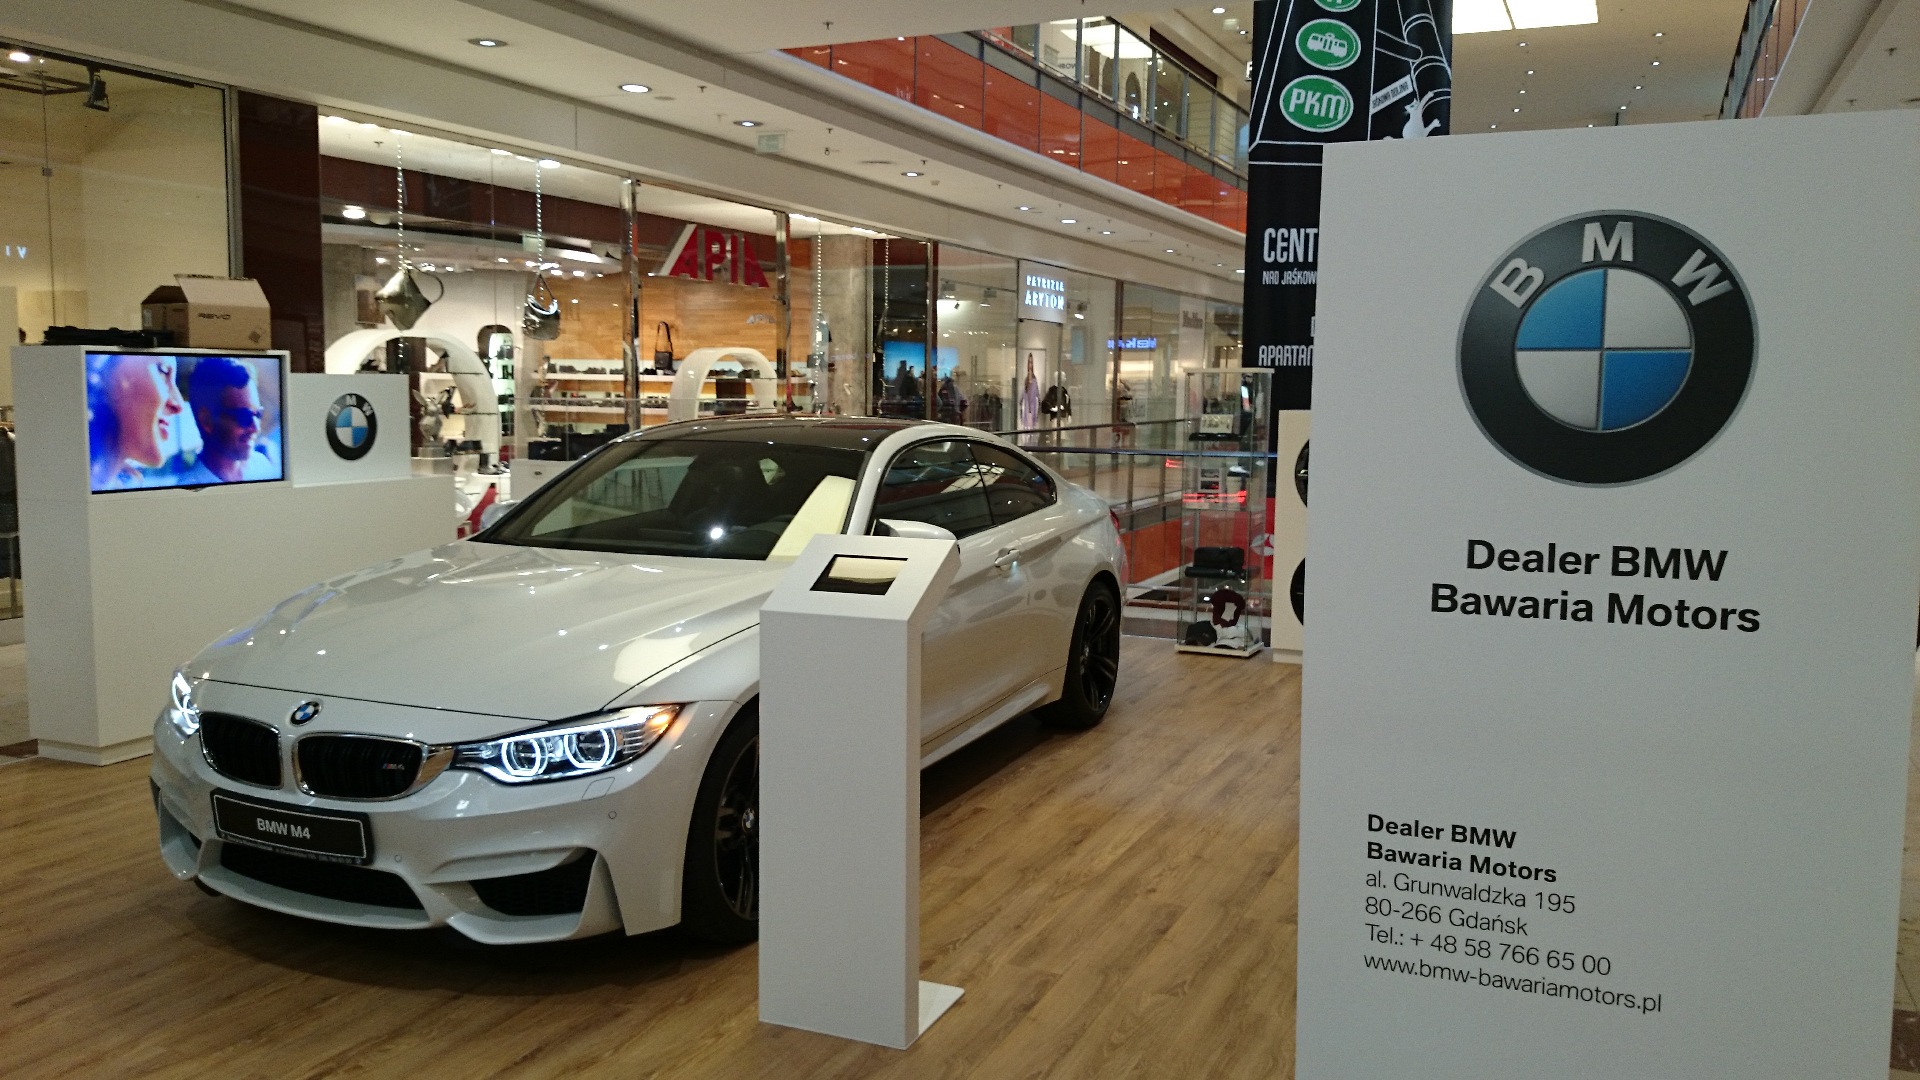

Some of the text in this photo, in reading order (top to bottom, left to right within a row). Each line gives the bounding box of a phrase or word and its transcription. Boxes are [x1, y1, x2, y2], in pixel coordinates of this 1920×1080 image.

[1288, 88, 1346, 121] PKM
[660, 224, 769, 288] APIA
[1263, 227, 1318, 263] CENT
[1488, 221, 1734, 309] BMW
[1262, 268, 1317, 285] NAD JAŚKOW
[1025, 290, 1065, 310] ARYTON
[1466, 539, 1729, 582] Dealer BMW
[1430, 582, 1761, 633] Bawaria Motors
[256, 818, 311, 840] BMW M4
[1367, 814, 1517, 849] Dealer BMW
[1367, 841, 1557, 883] Bawaria Motors
[1365, 870, 1576, 914] al. Grunwaldzka 195
[1365, 896, 1528, 936] 80-266 Gdańsk
[1365, 923, 1404, 946] Tel.:
[1430, 934, 1457, 954] 48
[1464, 938, 1491, 959] 58
[1499, 943, 1540, 966] 766
[1546, 949, 1575, 971] 65
[1582, 955, 1611, 975] 00
[1363, 953, 1662, 1015] www.bmw-bawariamotors.pl
